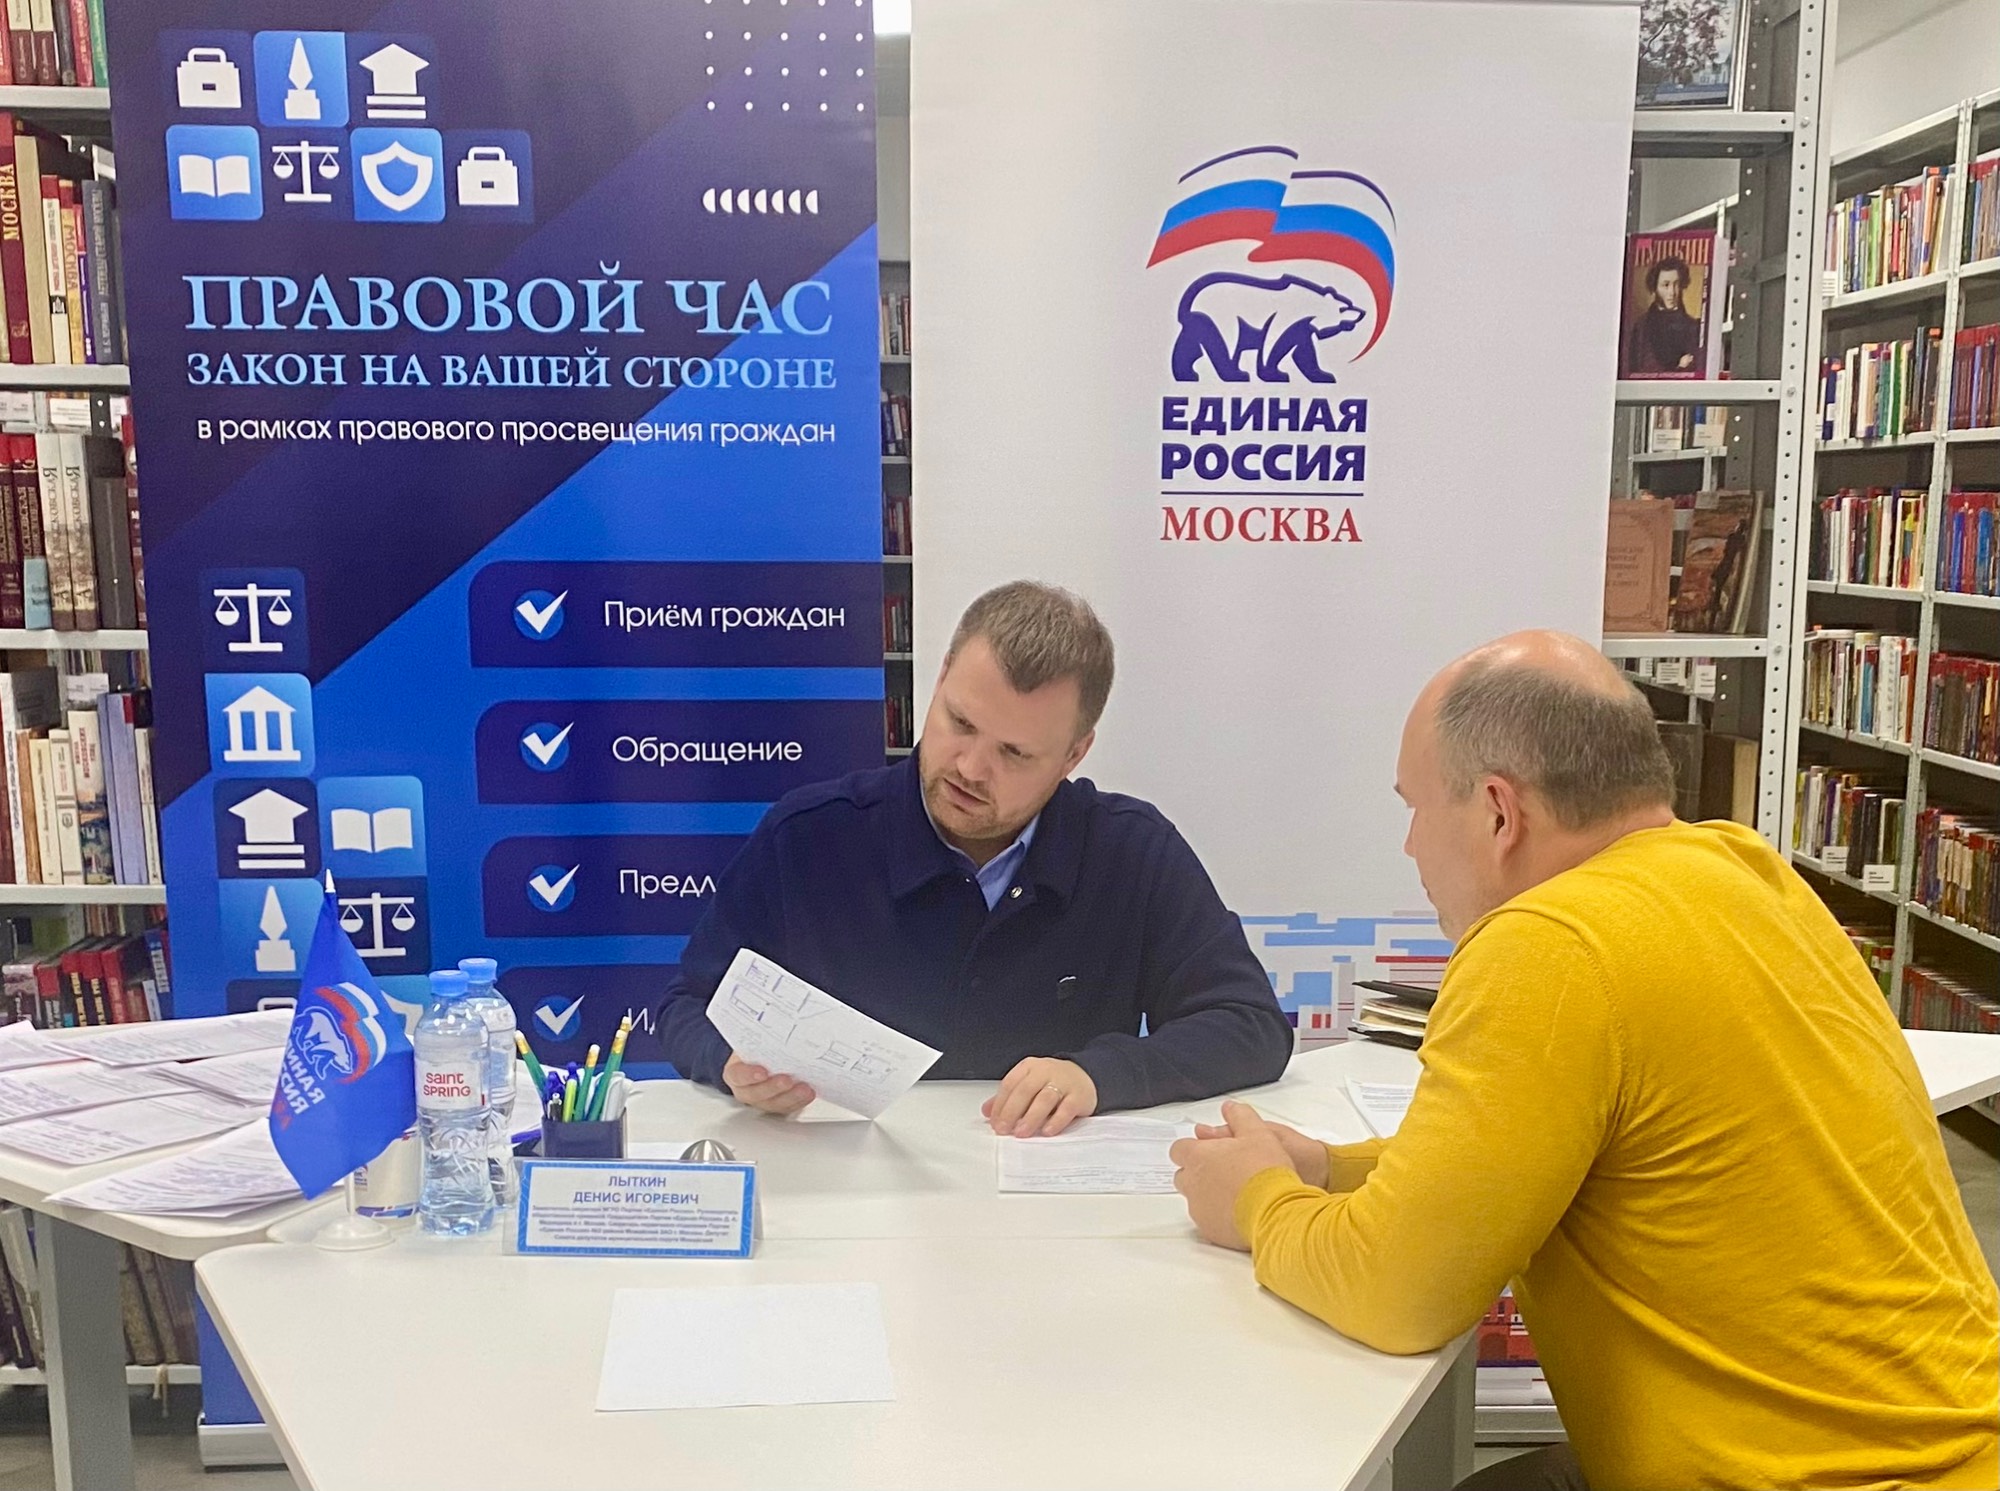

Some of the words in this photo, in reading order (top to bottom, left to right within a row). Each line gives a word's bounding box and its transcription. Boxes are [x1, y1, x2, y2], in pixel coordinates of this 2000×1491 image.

[1, 163, 20, 241] МОСКВА
[64, 224, 79, 290] МОСКВА
[182, 260, 645, 333] ПРАВОВОЙ
[665, 278, 833, 335] ЧАС
[187, 352, 347, 386] ЗАКОН
[360, 354, 431, 386] НА
[441, 346, 612, 388] ВАШЕЙ
[623, 355, 837, 389] СТОРОНЕ
[1162, 396, 1368, 436] ЕДИНАЯ
[198, 420, 213, 440] в
[219, 420, 332, 445] рамках
[339, 420, 495, 446] правового
[502, 421, 703, 446] просвещения
[711, 422, 836, 448] граждан
[1161, 442, 1366, 482] РОССИЯ
[1160, 506, 1363, 543] МОСКВА
[604, 600, 703, 633] Приём
[711, 607, 846, 633] граждан
[612, 735, 803, 768] Обращение
[619, 869, 717, 900] Предл
[627, 1007, 656, 1036] И
[287, 1037, 326, 1106] ИНАЯ
[423, 1085, 471, 1097] SPRING
[573, 1191, 621, 1204] ДЕНИС
[625, 1192, 699, 1205] ИГОРЕВИЧ
[608, 1176, 667, 1188] ЛЫТКИН
